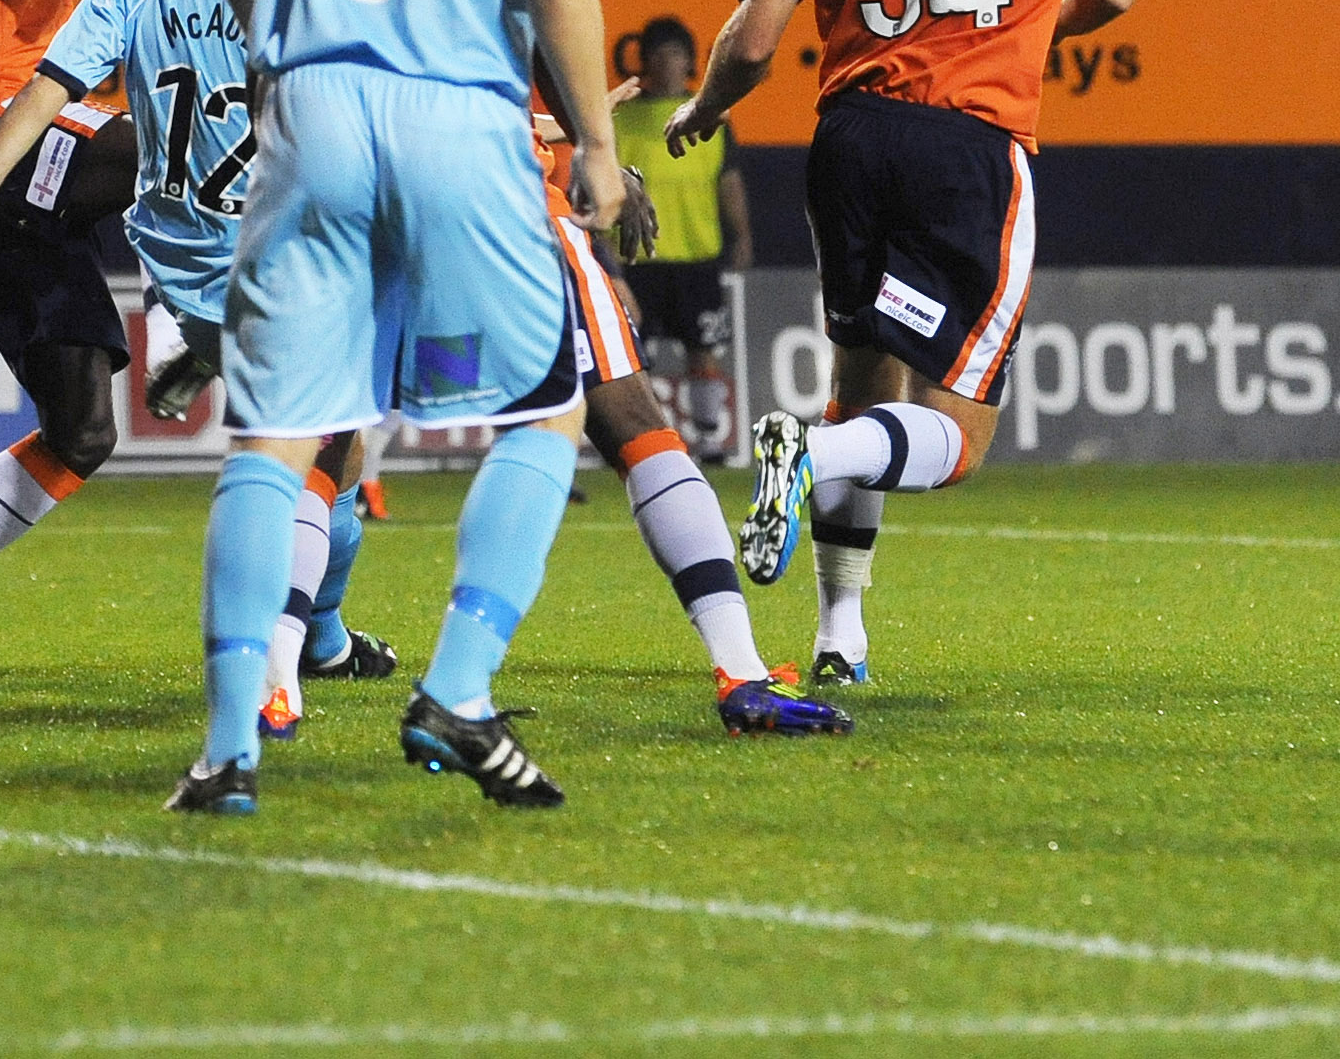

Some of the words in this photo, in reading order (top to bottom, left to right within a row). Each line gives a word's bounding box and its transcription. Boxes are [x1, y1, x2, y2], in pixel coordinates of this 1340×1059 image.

[161, 2, 248, 50] McAU
[149, 62, 259, 220] 12
[884, 304, 931, 335] niceic.com
